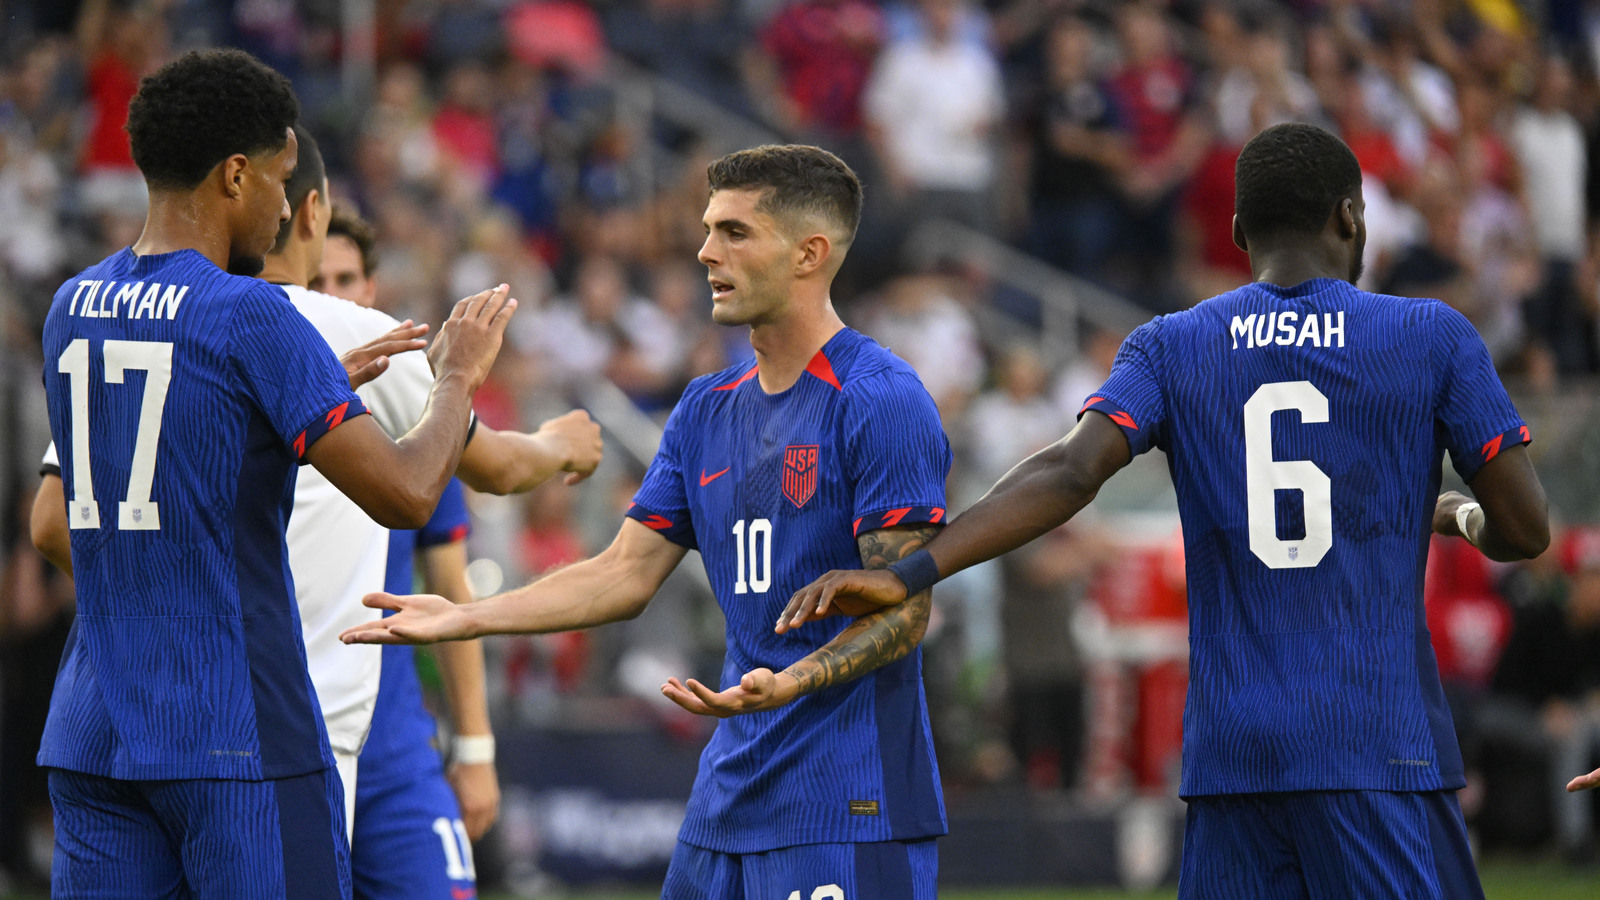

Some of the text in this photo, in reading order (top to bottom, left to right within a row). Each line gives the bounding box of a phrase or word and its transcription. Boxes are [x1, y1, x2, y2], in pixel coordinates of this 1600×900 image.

[69, 279, 189, 320] TILLMAN
[1230, 310, 1345, 350] MUSAH
[58, 338, 174, 531] 17
[787, 448, 817, 472] USA
[1244, 380, 1333, 569] 6
[732, 518, 772, 594] 10
